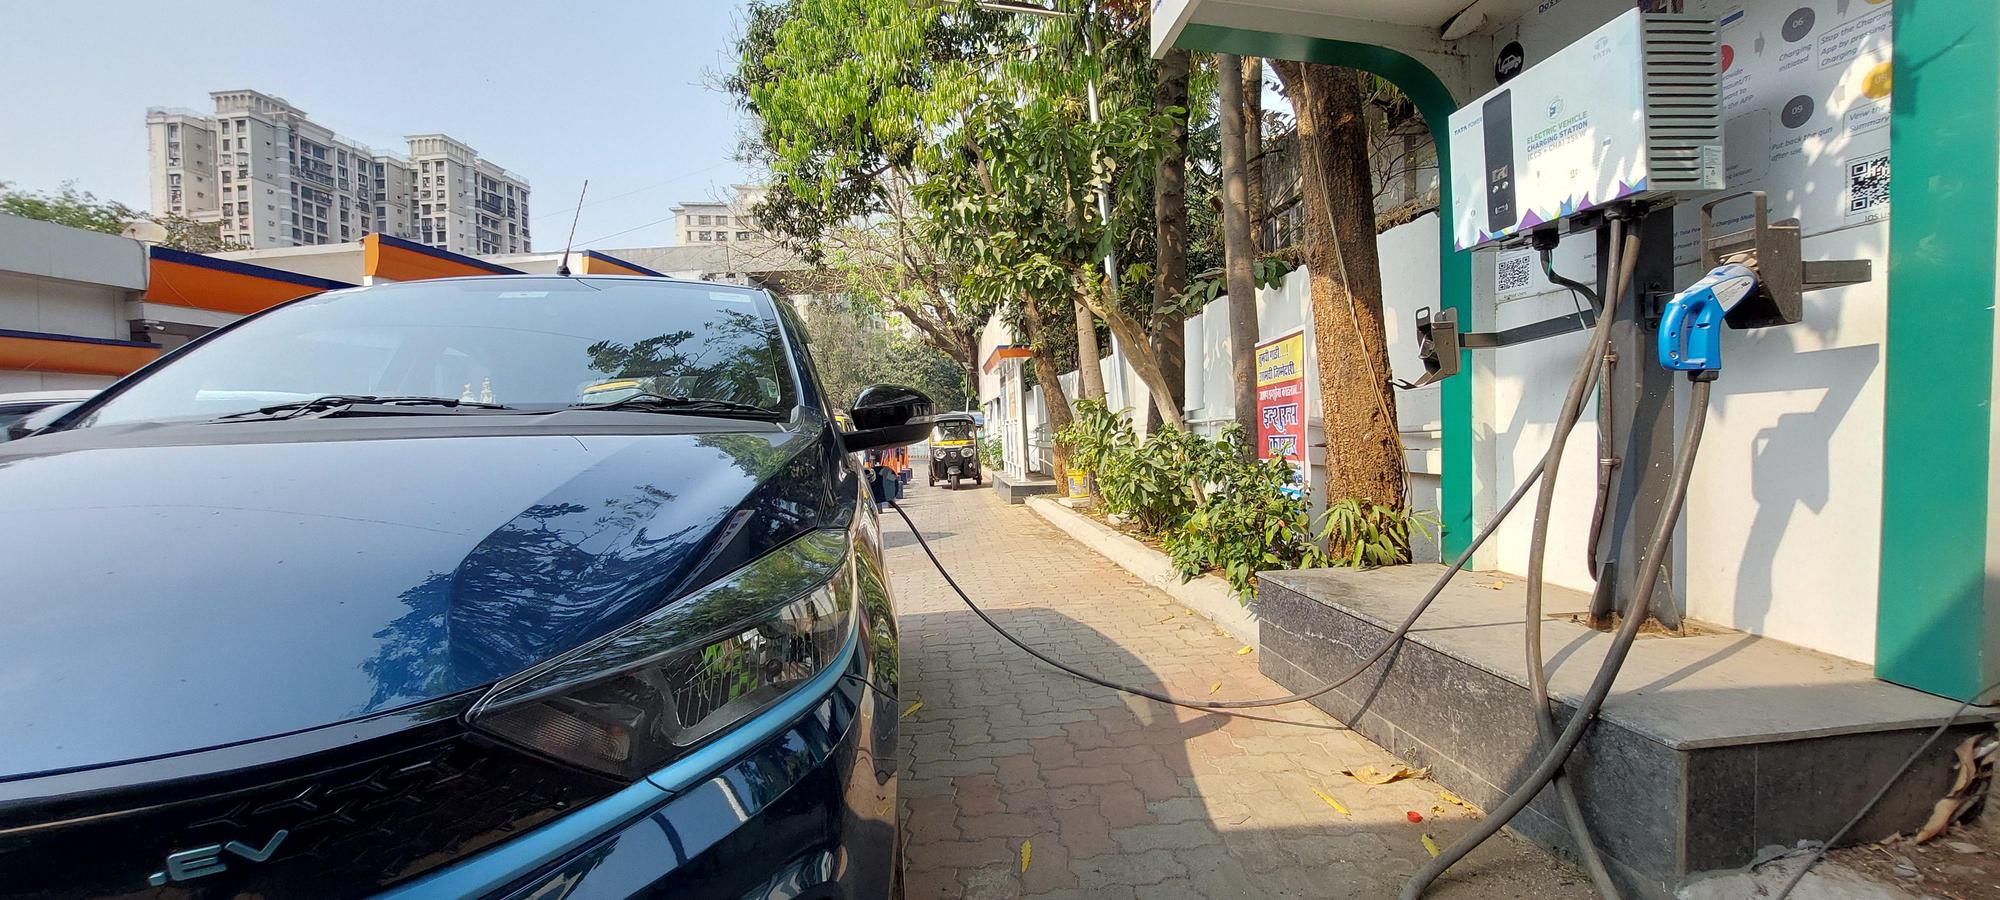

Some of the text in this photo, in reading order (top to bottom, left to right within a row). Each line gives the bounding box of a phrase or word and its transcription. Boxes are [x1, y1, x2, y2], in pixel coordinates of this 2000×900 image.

[1792, 18, 1804, 29] 06
[1820, 31, 1840, 46] Stop
[1841, 24, 1855, 36] the
[1778, 43, 1813, 63] Charging
[1820, 43, 1838, 57] App
[1838, 39, 1849, 51] by
[1820, 47, 1858, 66] Charging
[1791, 104, 1803, 115] 09
[1527, 110, 1588, 144] ELECTRIC VEHICLE
[1527, 119, 1588, 153] CHARGING STATION
[1772, 140, 1784, 151] Put
[1784, 133, 1801, 148] back
[1818, 127, 1833, 139] gun
